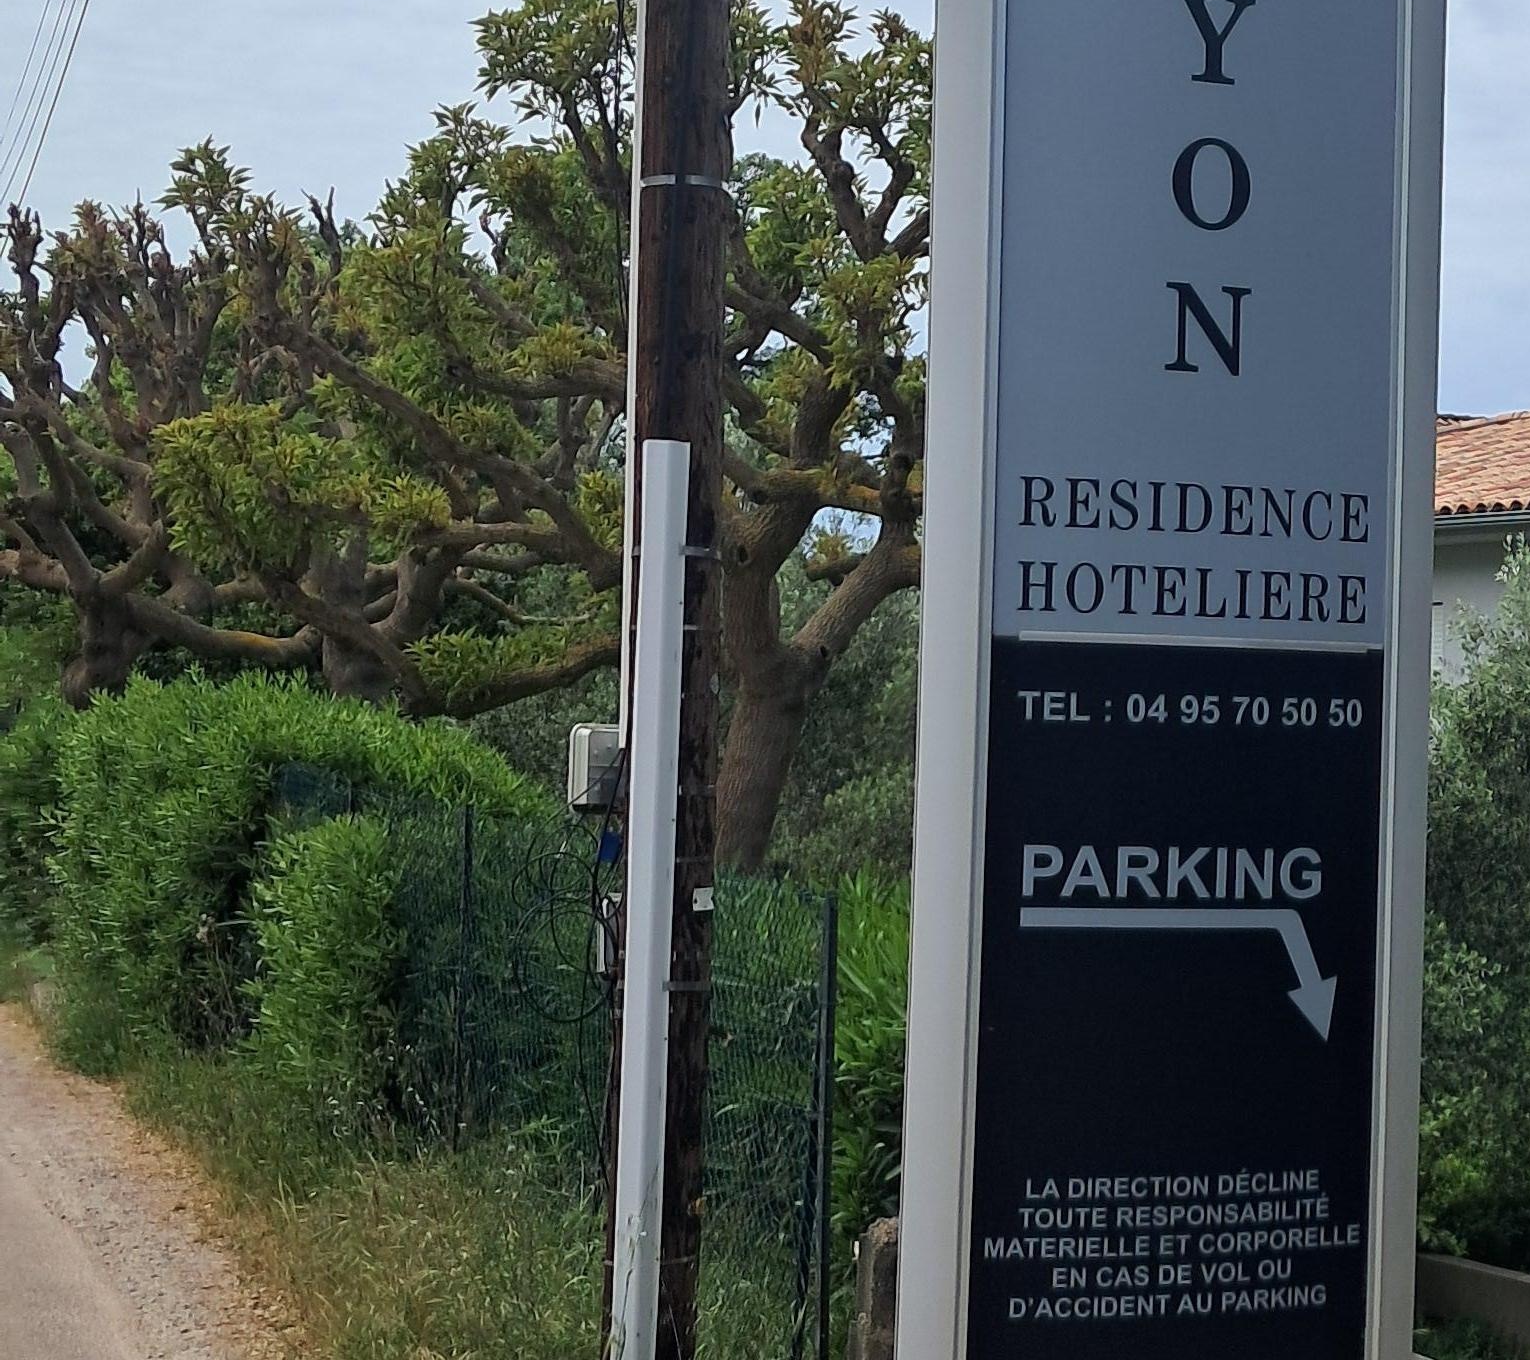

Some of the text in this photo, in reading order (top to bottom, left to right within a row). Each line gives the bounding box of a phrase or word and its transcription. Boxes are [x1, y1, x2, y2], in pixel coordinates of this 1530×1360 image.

[1018, 476, 1369, 543] RESIDENCE
[1016, 561, 1366, 624] HOTELIERE
[1018, 691, 1090, 722] TEL
[1127, 694, 1168, 723] 04
[1180, 695, 1220, 724] 95
[1232, 697, 1269, 725] 70
[1282, 698, 1316, 726] 50
[1328, 699, 1363, 727] 50
[1021, 844, 1322, 899] PARKING
[1026, 1169, 1319, 1200] LA DIRECTION DÉCLINE
[1019, 1192, 1329, 1229] TOUTE RESPONSABILITÉ
[983, 1223, 1360, 1259] MATERIELLE ET CORPORELLE
[1052, 1258, 1291, 1289] EN CAS DE VOL OU
[1008, 1285, 1326, 1318] D'ACCIDENT AU PARKING
